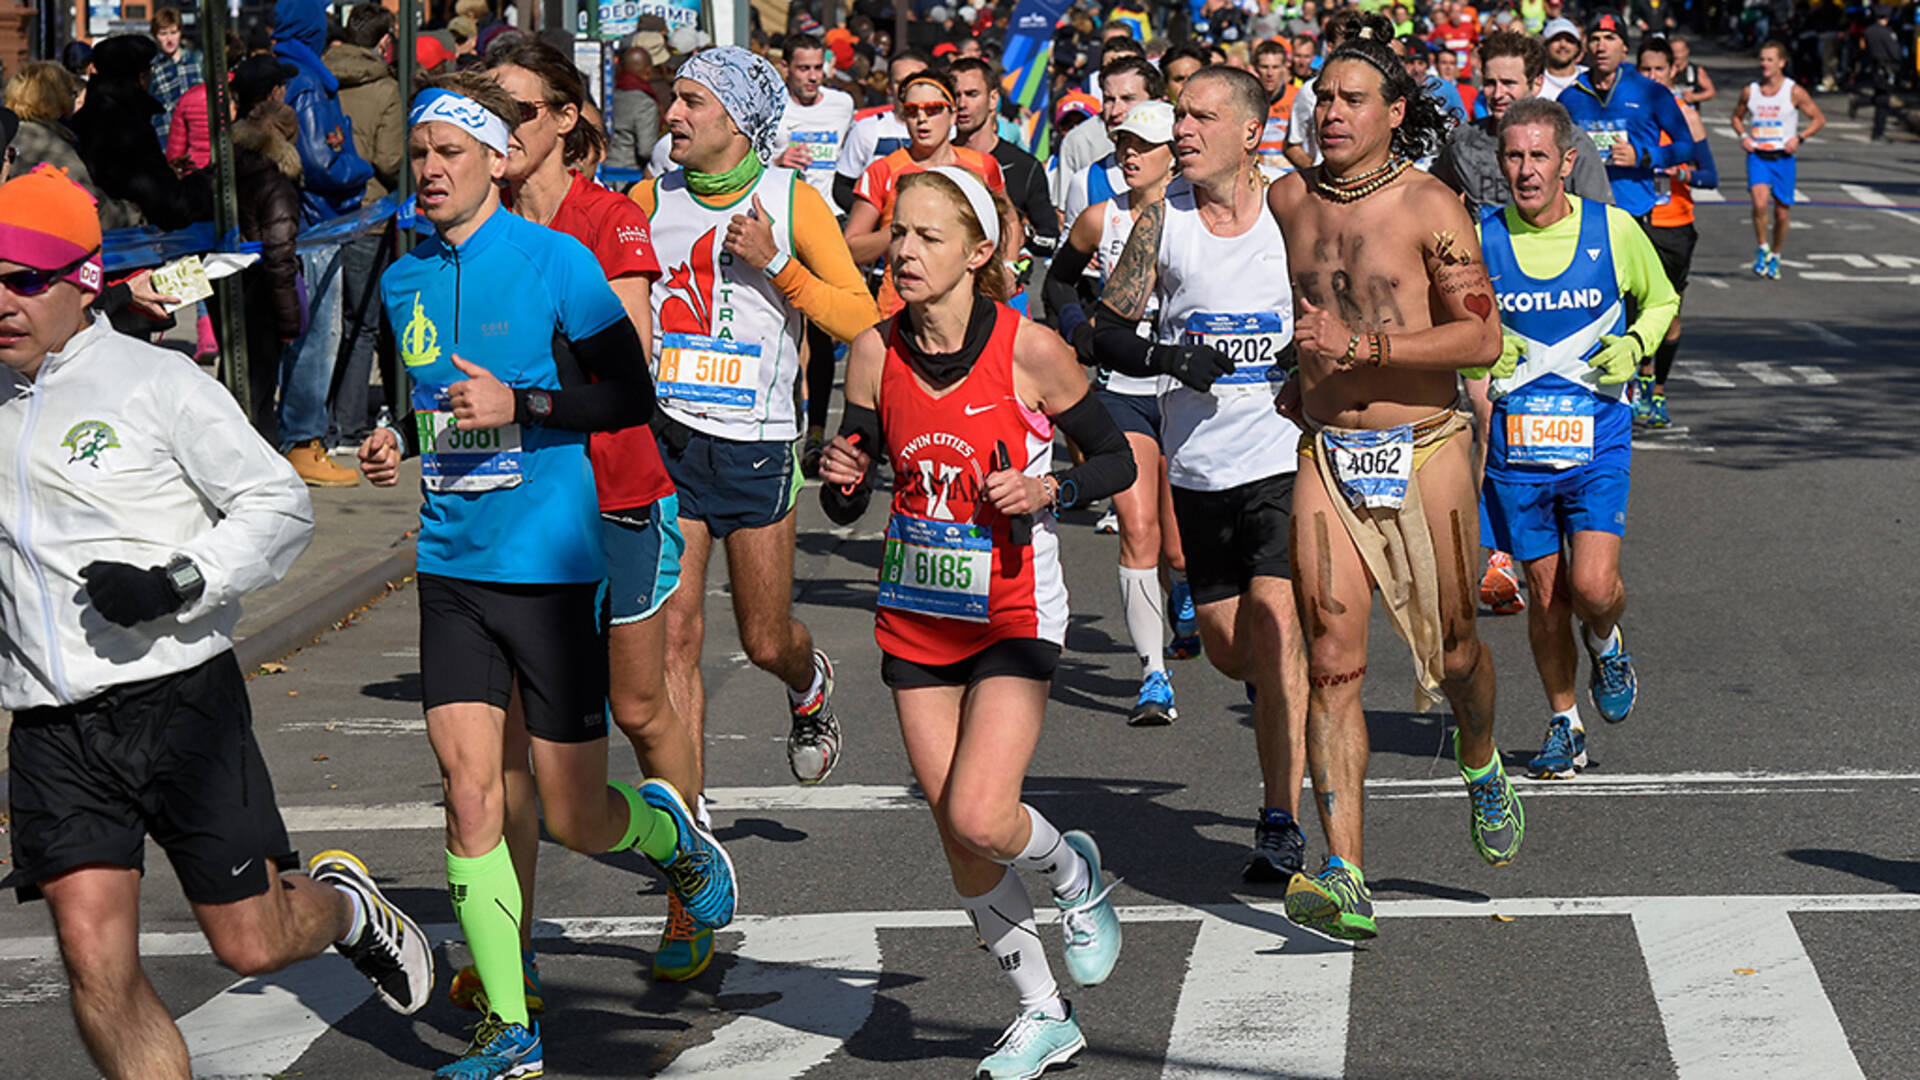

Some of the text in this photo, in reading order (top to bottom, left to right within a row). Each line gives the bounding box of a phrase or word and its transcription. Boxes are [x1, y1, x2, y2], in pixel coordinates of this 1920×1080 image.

[642, 4, 695, 25] GAME
[1496, 288, 1602, 312] SCOTLAND
[695, 355, 742, 385] 5110
[1531, 419, 1584, 443] 5409
[900, 432, 975, 460] TWIN CITIES
[1346, 446, 1401, 475] 4062
[914, 551, 973, 589] 6185
